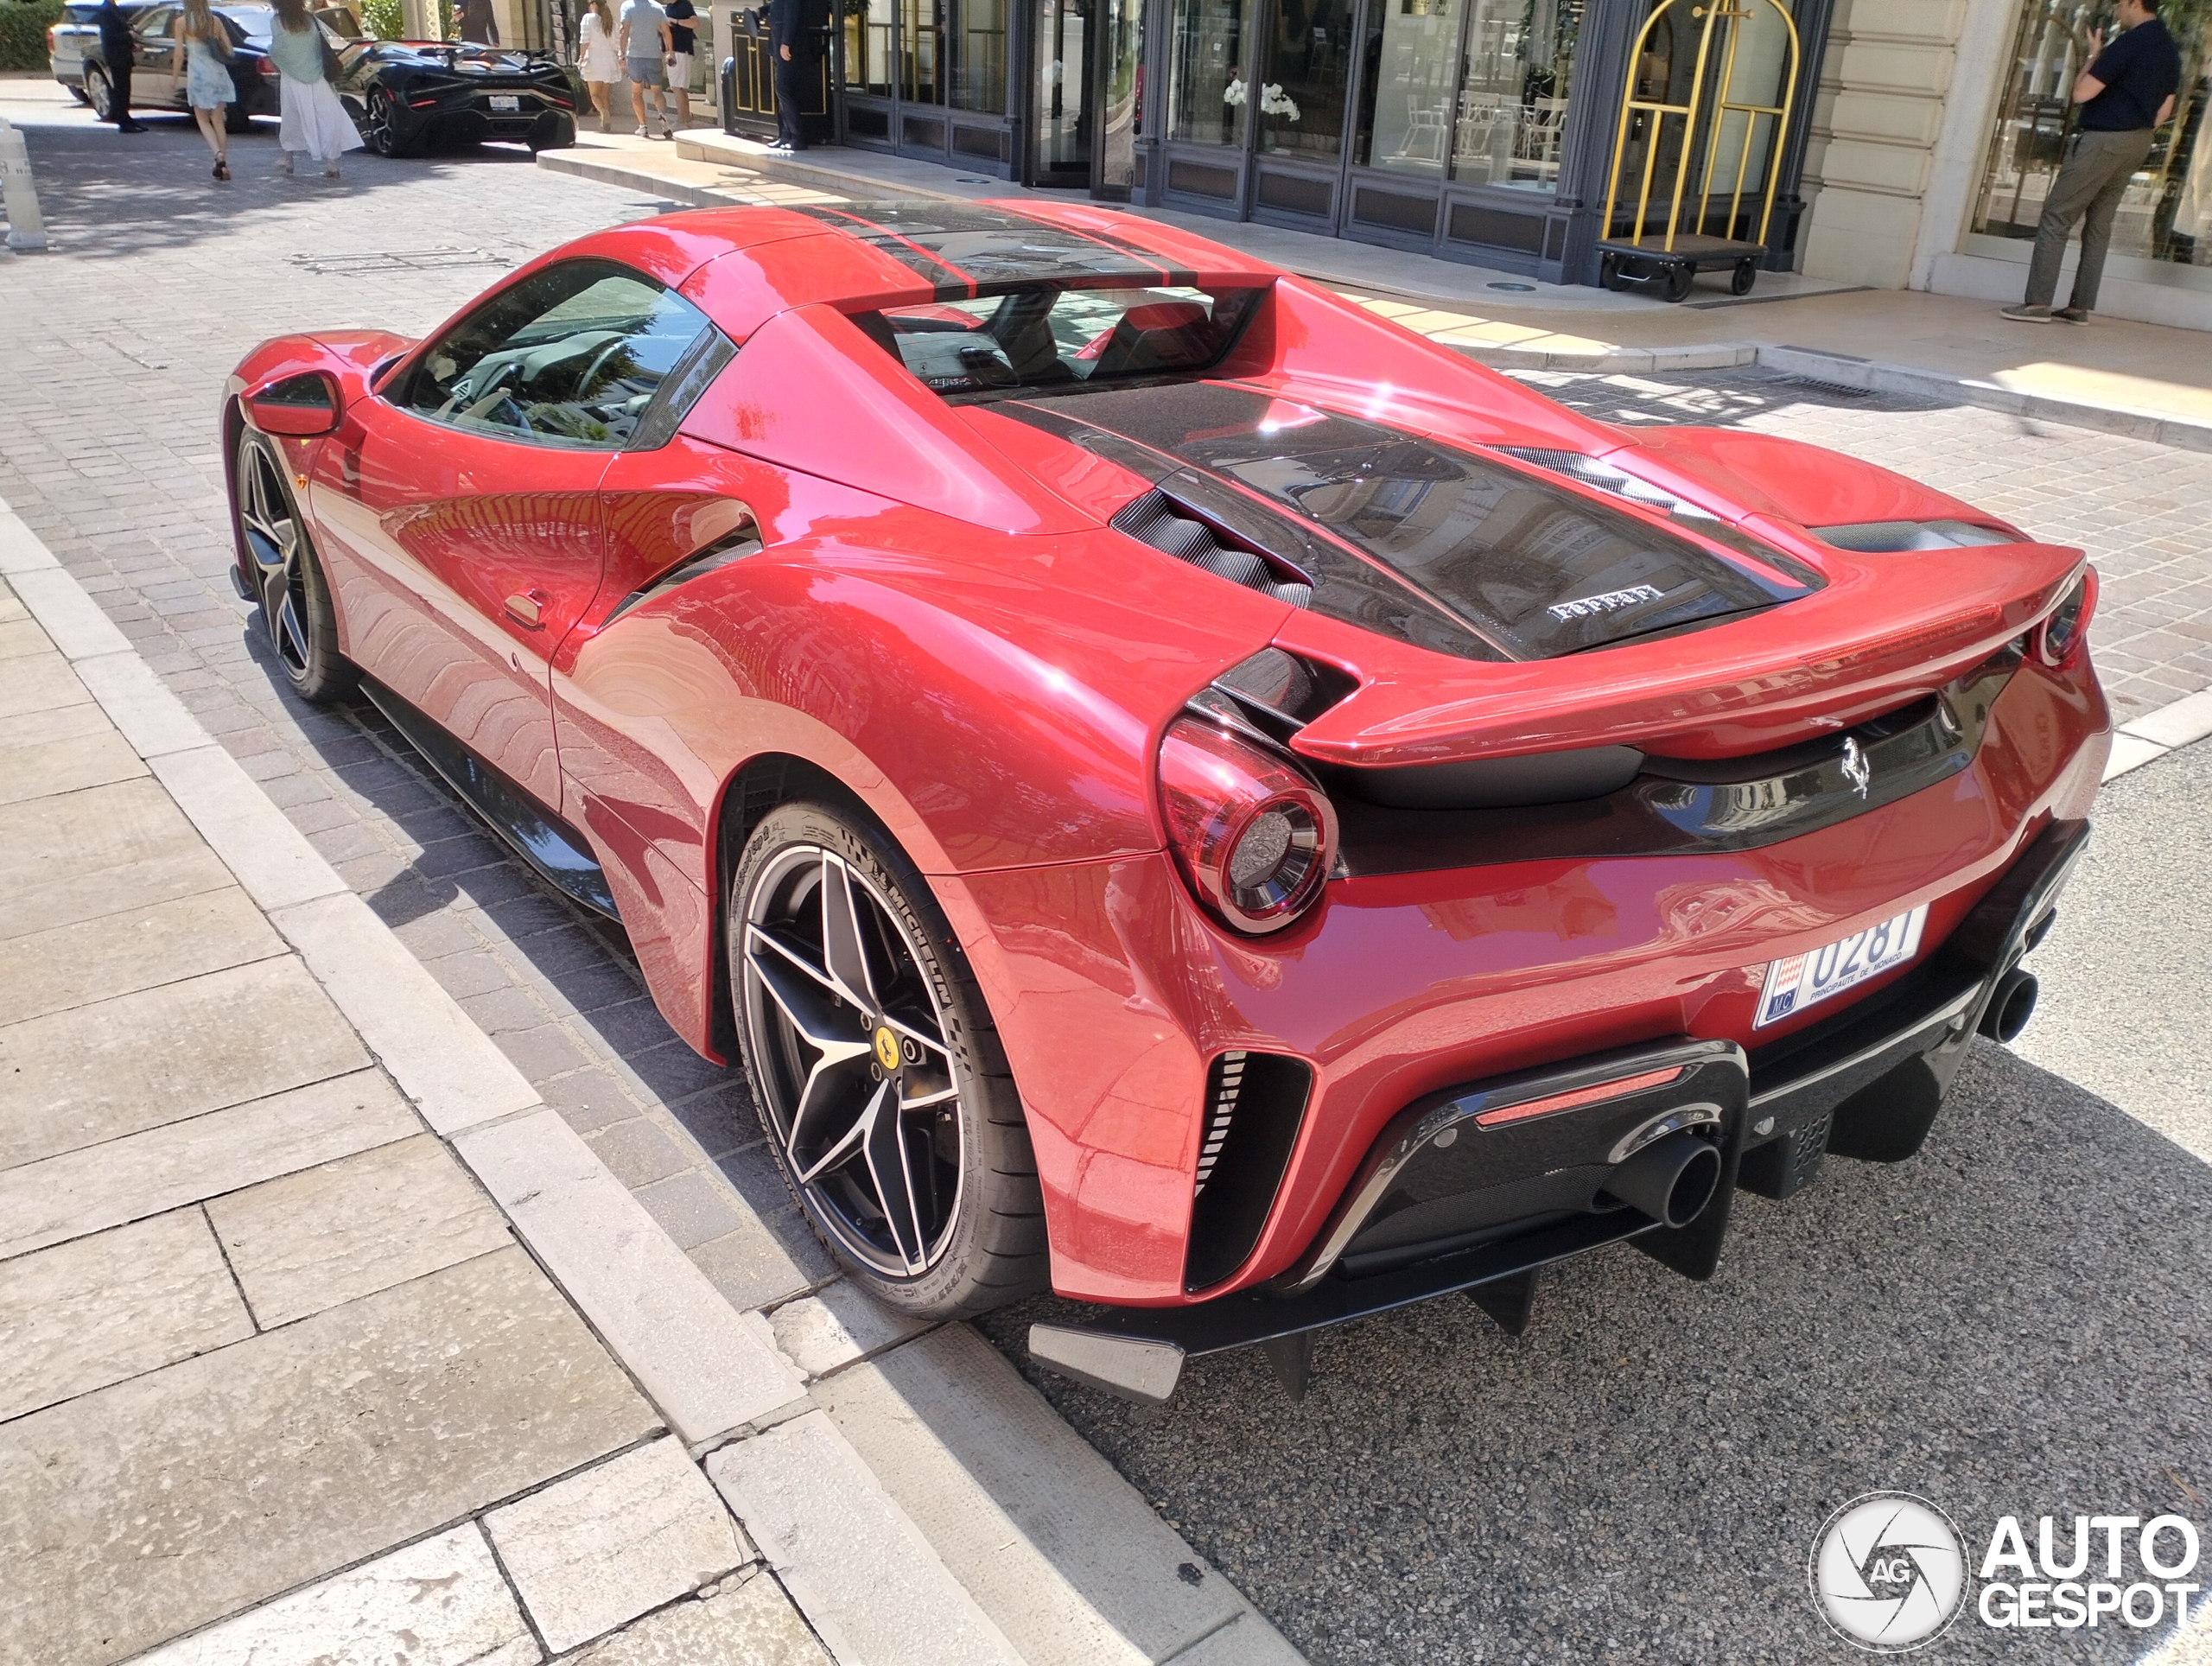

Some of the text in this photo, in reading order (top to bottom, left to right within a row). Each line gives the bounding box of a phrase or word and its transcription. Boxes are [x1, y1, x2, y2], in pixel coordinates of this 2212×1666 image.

[1547, 584, 1665, 623] Ferrari
[888, 886, 953, 1005] MICHELIN
[1810, 951, 1903, 1001] PRINCIPAUTE DE MONACO
[1772, 992, 1792, 1014] MC
